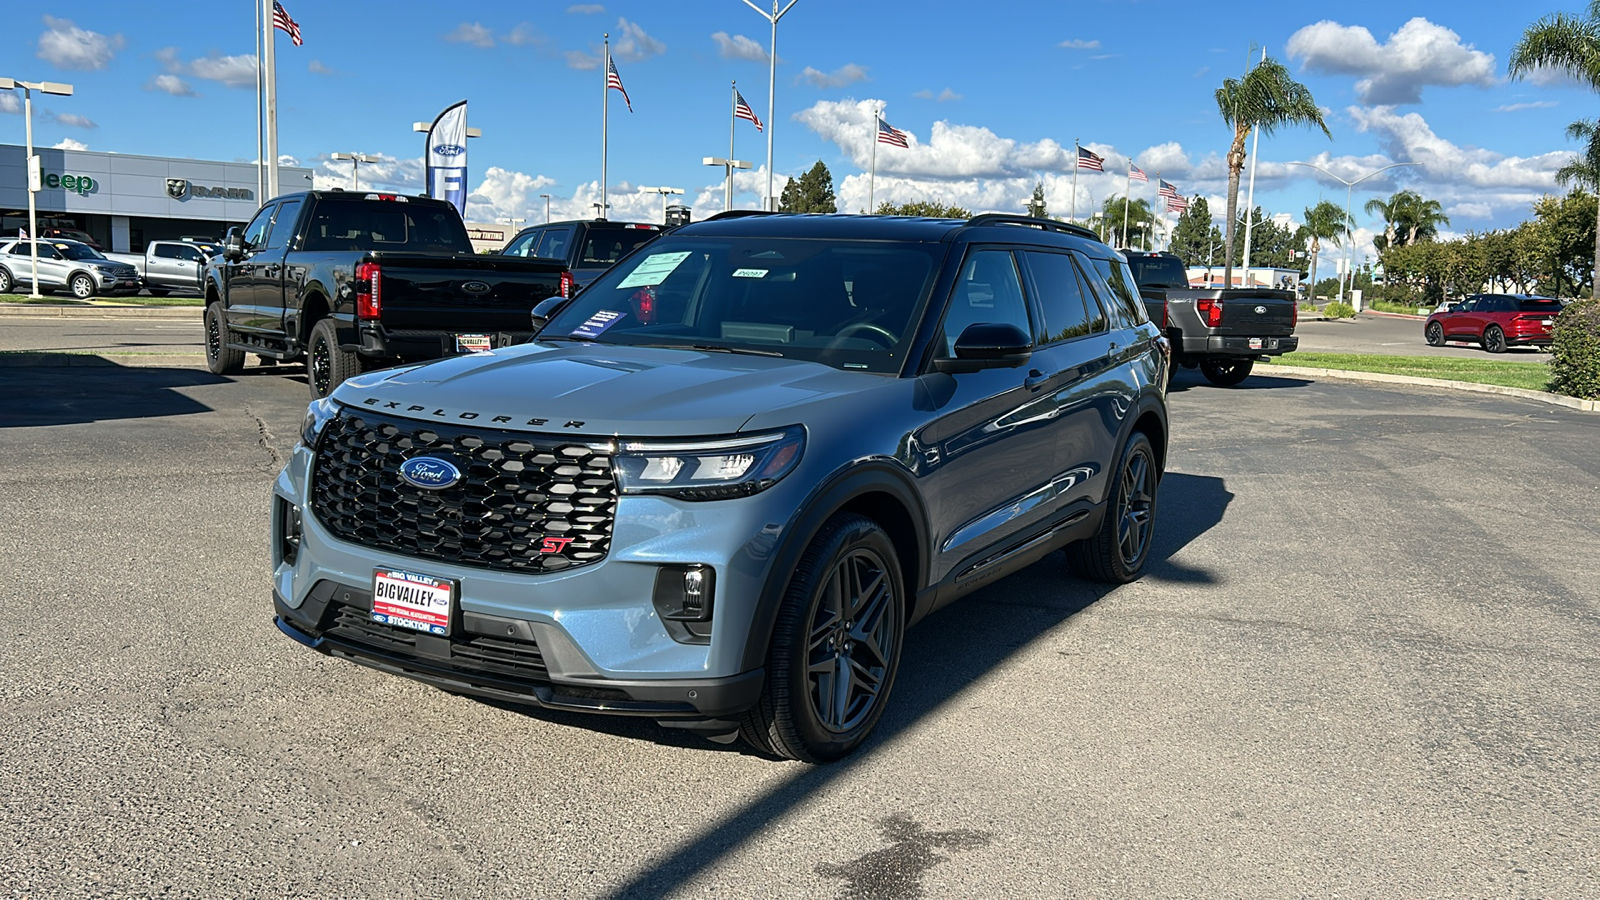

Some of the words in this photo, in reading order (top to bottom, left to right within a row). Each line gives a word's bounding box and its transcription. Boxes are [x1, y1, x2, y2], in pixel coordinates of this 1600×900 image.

[191, 185, 250, 200] RAM
[363, 398, 585, 428] EXPLORER
[411, 462, 445, 482] Ford
[541, 536, 575, 553] ST
[406, 574, 433, 585] VALLEY
[377, 582, 434, 607] BIGVALLEY
[388, 615, 430, 631] STOCKTON
